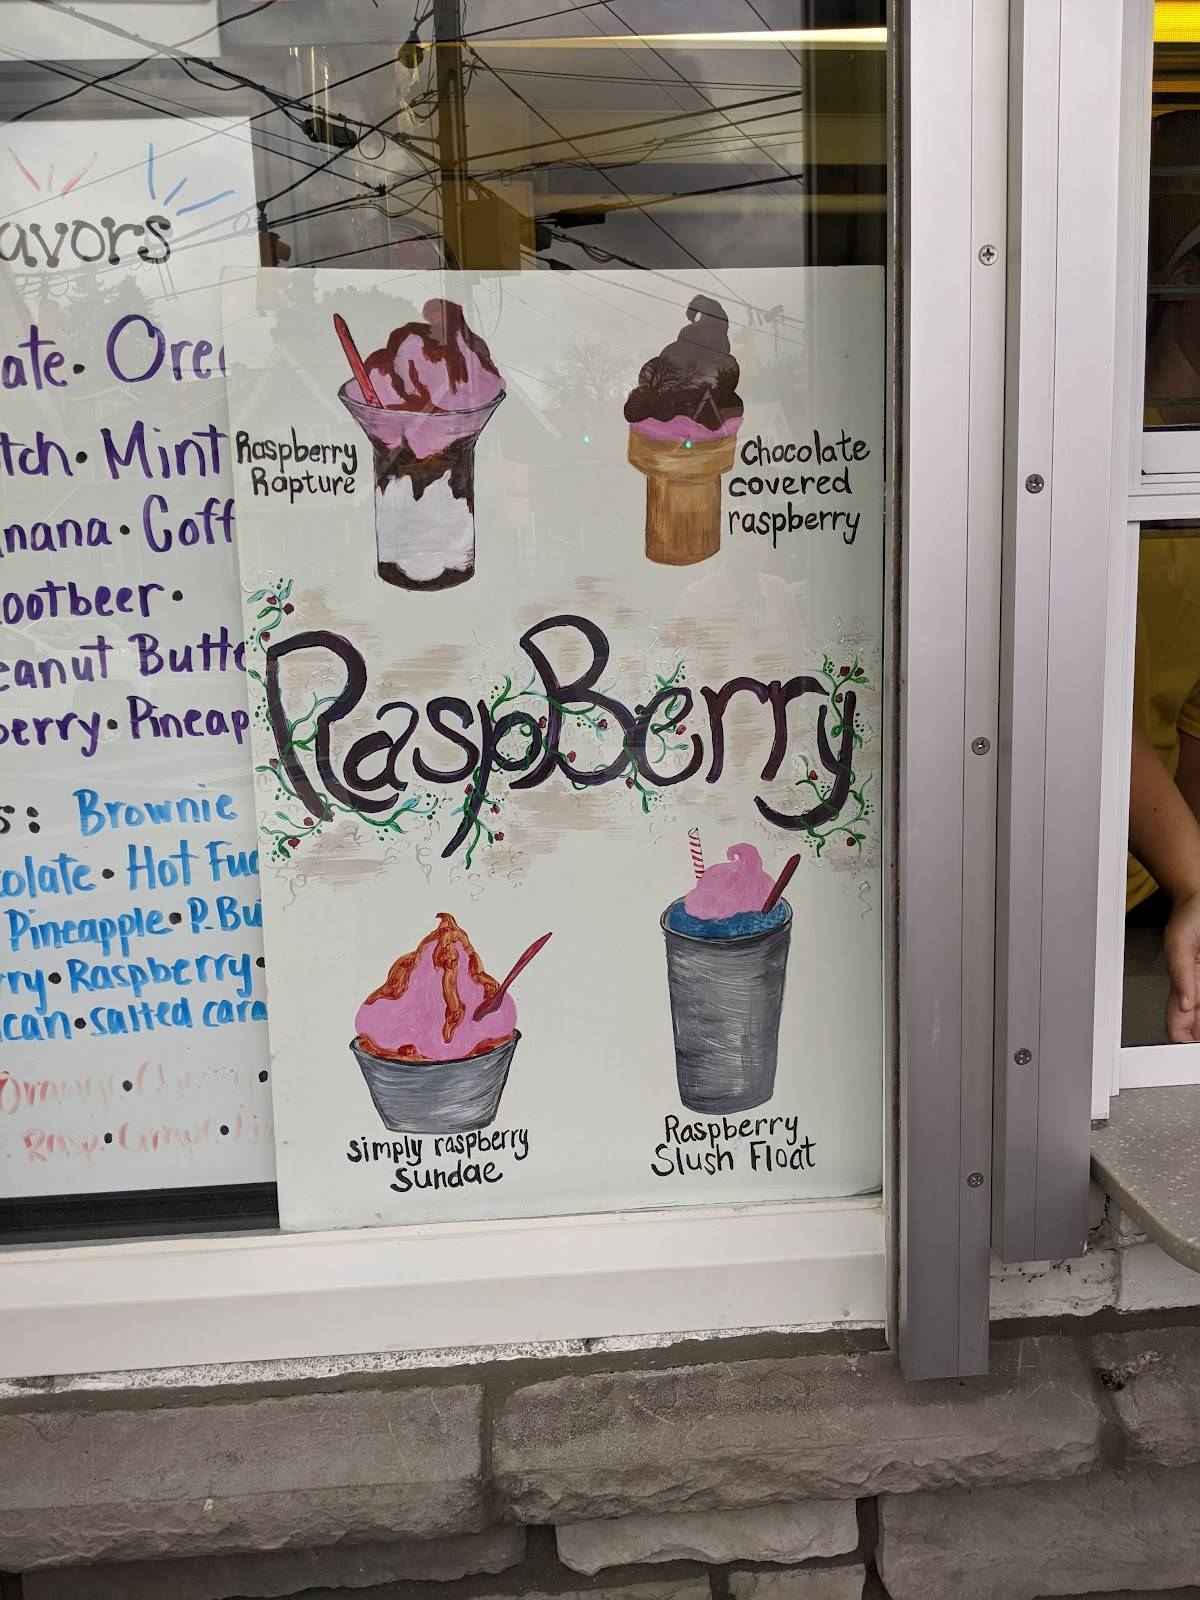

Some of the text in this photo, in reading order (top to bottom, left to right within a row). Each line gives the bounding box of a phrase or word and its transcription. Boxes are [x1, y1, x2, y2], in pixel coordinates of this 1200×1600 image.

[2, 325, 68, 391] ate
[100, 420, 228, 480] Mint
[236, 425, 358, 474] Raspberry
[740, 429, 871, 466] Chocolate
[251, 467, 356, 504] Rapture
[728, 466, 852, 497] covered
[0, 494, 236, 557] nana Coff
[728, 501, 861, 549] raspberry
[0, 580, 165, 625] ootbeer
[72, 784, 239, 837] Brownie
[0, 852, 97, 899] olate
[127, 839, 201, 891] Hot
[4, 907, 174, 958] Pineapple
[66, 953, 253, 998] Raspberry
[0, 997, 268, 1042] can salted cara
[346, 1128, 530, 1167] simply raspberry
[664, 1114, 798, 1148] Raspberry
[650, 1136, 817, 1177] Slush Float
